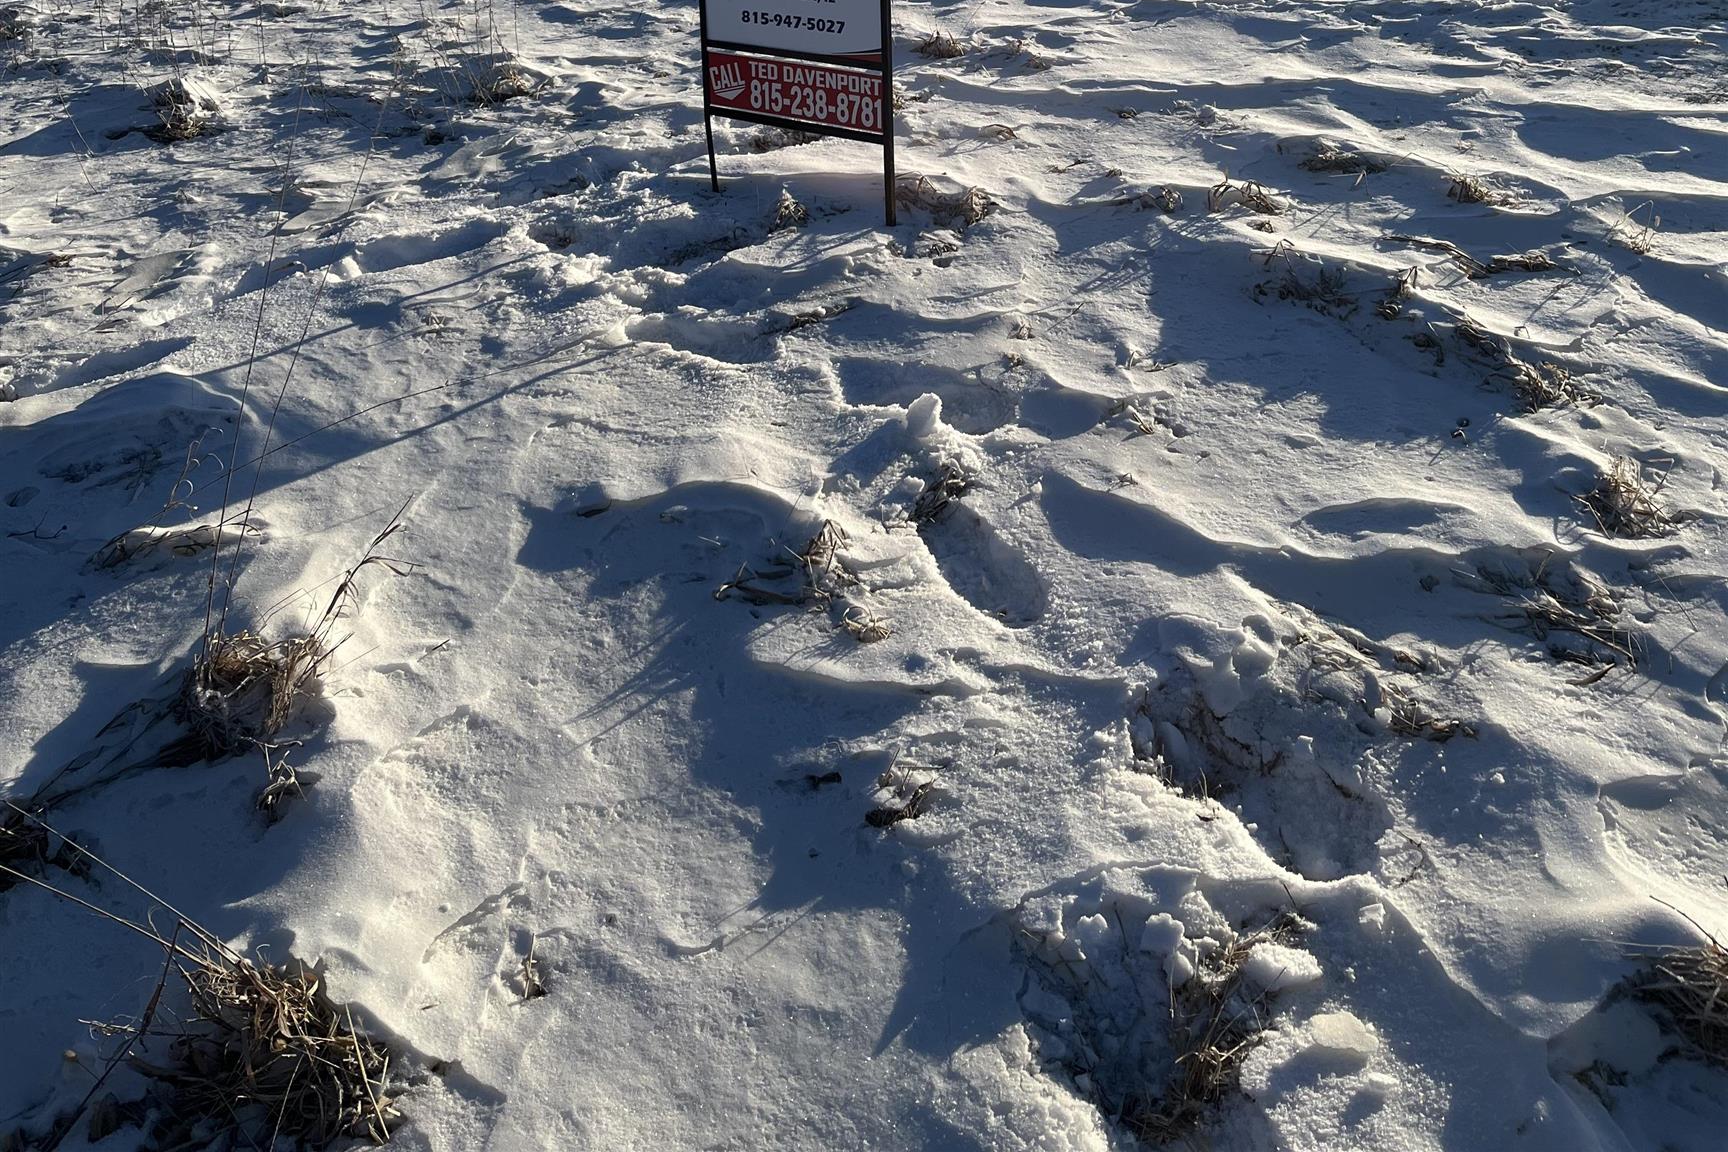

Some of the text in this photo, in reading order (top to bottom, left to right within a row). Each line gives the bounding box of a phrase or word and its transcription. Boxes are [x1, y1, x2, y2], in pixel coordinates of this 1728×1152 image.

[741, 10, 845, 34] 815-947-5027
[709, 62, 745, 91] CALL
[749, 61, 882, 96] TED DAVENPORT
[750, 79, 882, 129] 815-238-8781
